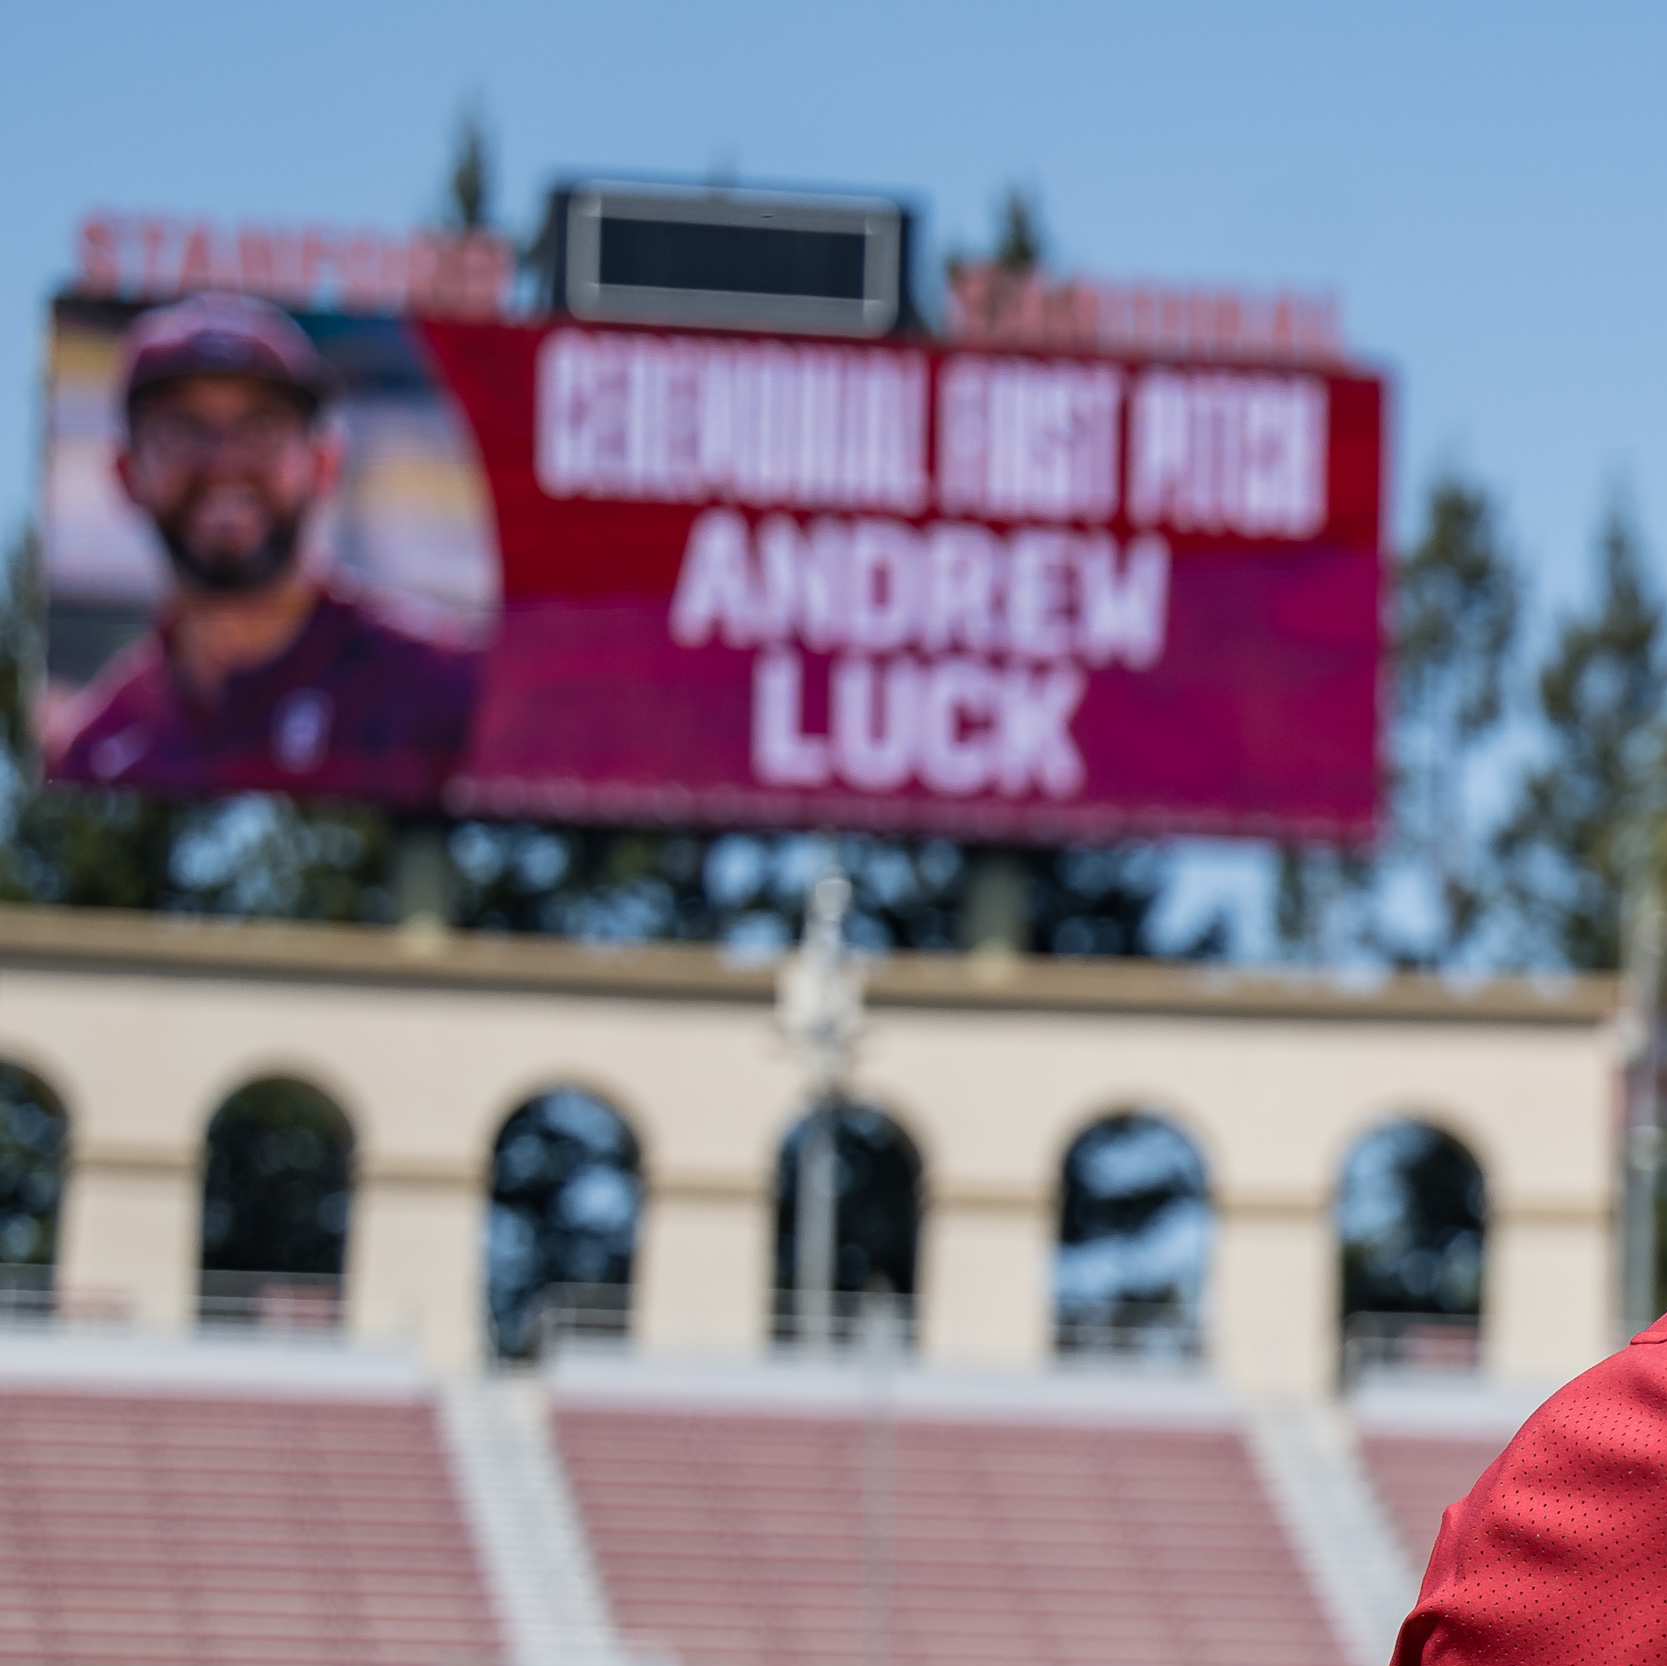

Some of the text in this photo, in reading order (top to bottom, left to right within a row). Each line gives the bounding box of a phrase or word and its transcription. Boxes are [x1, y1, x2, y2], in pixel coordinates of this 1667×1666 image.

[936, 350, 1122, 525] FIRST
[1127, 366, 1328, 538] PITCH
[670, 510, 1171, 672] ANDREW
[750, 644, 1087, 797] LUCK
